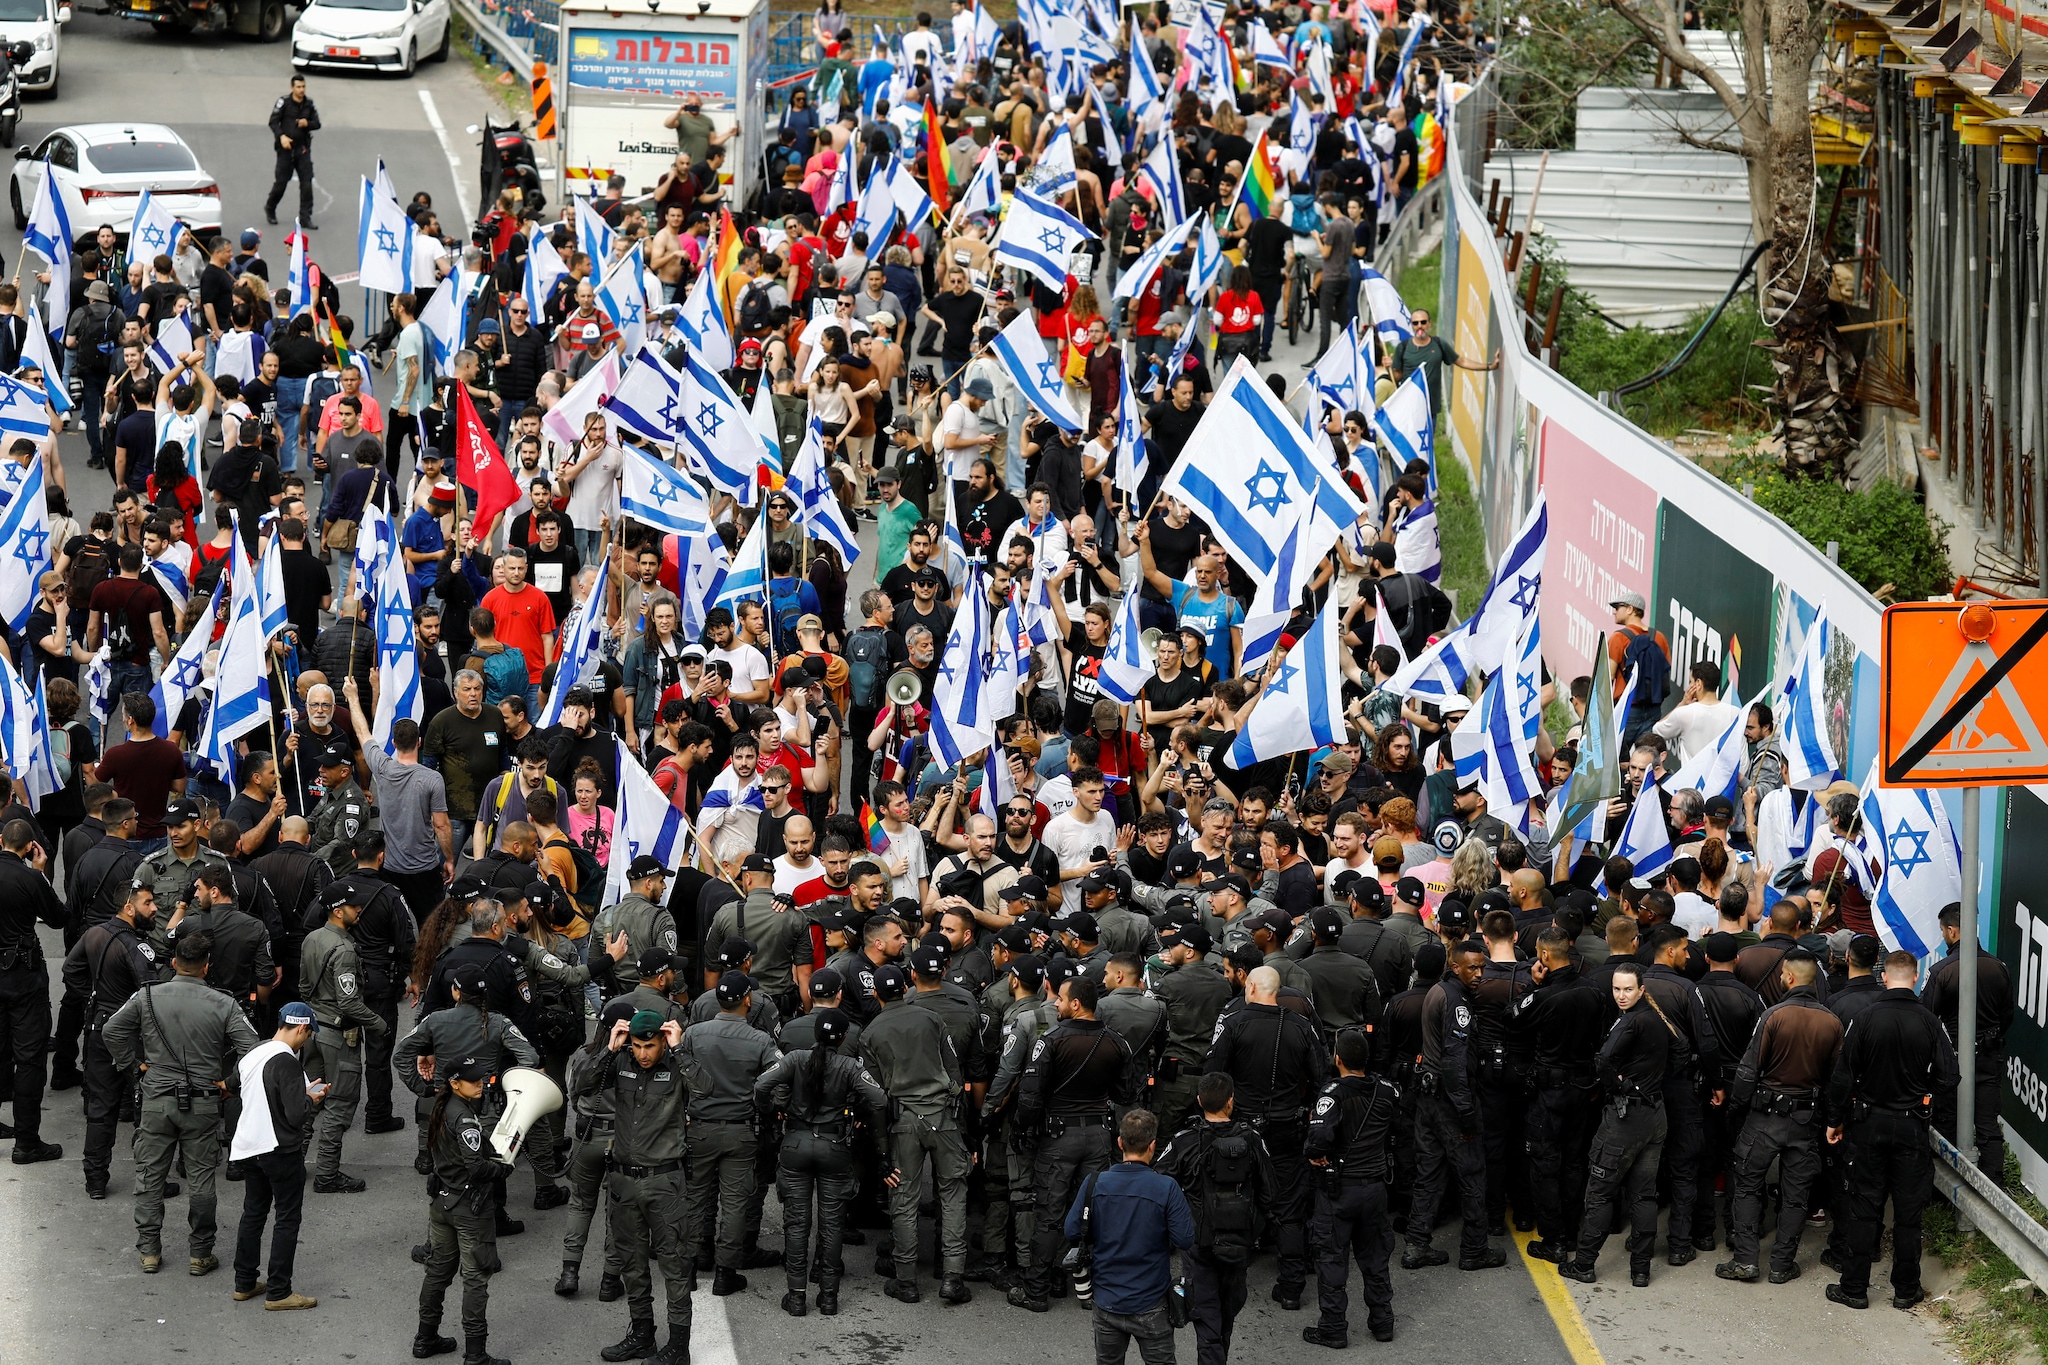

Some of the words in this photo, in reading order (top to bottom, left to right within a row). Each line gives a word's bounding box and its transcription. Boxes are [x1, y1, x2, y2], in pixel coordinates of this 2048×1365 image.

[615, 36, 730, 65] הובלות
[572, 64, 603, 73] והרכבה
[605, 65, 629, 75] פירוק
[638, 66, 667, 75] וגדולות
[669, 68, 694, 78] קטנות
[696, 69, 724, 78] הובלות
[608, 76, 633, 85] אריזה
[644, 77, 664, 87] מנוף
[667, 78, 696, 87] שירותי
[618, 140, 640, 153] Levi
[1591, 498, 1616, 553] דירה
[1617, 517, 1645, 574] תכנון
[1564, 541, 1595, 600] אישית
[1566, 603, 1594, 663] תדהר
